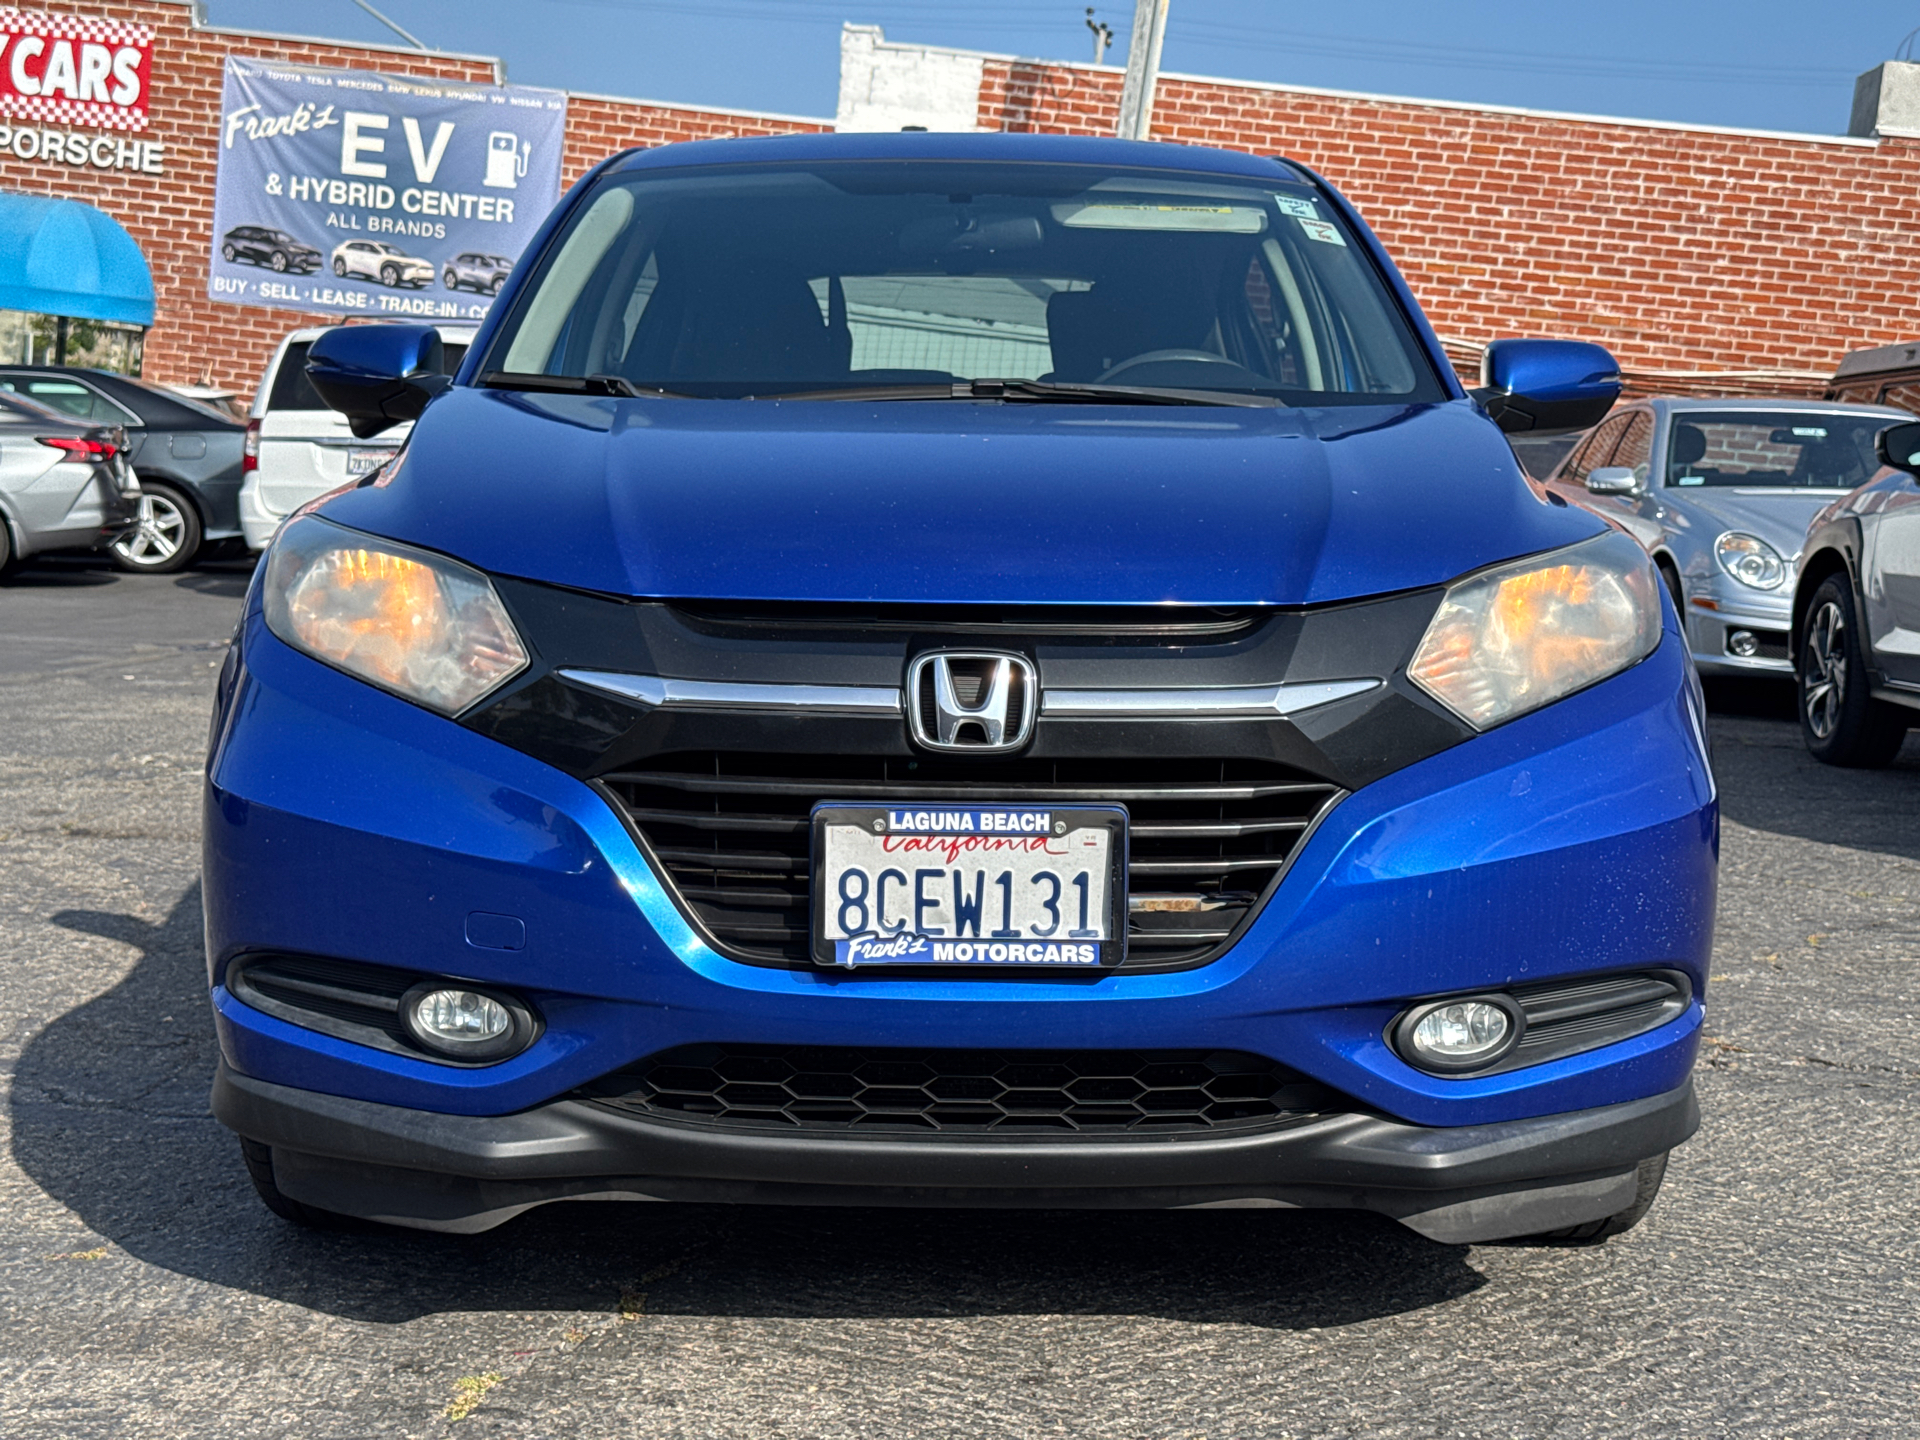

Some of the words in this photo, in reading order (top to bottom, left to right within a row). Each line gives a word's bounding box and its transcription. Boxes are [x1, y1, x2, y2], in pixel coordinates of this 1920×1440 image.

[11, 36, 142, 106] CARS
[307, 77, 333, 86] TESLA
[337, 79, 384, 92] MERCEDES
[446, 91, 487, 103] HYUNDAI
[225, 103, 339, 149] Frank's
[341, 111, 456, 183] EV
[264, 173, 283, 196] &
[289, 174, 395, 210] HYBRID
[401, 188, 515, 223] CENTER
[326, 213, 361, 231] ALL
[368, 216, 446, 240] BRANDS
[213, 277, 248, 296] BUY
[259, 282, 301, 301] SELL
[312, 289, 367, 309] LEASE
[378, 295, 457, 318] TRADE-IN
[890, 812, 974, 832] LAGUNA
[980, 812, 1050, 832] BEACH
[838, 867, 1100, 937] 8CEW131
[847, 933, 929, 966] Frank's
[933, 943, 1095, 963] MOTORCARS
